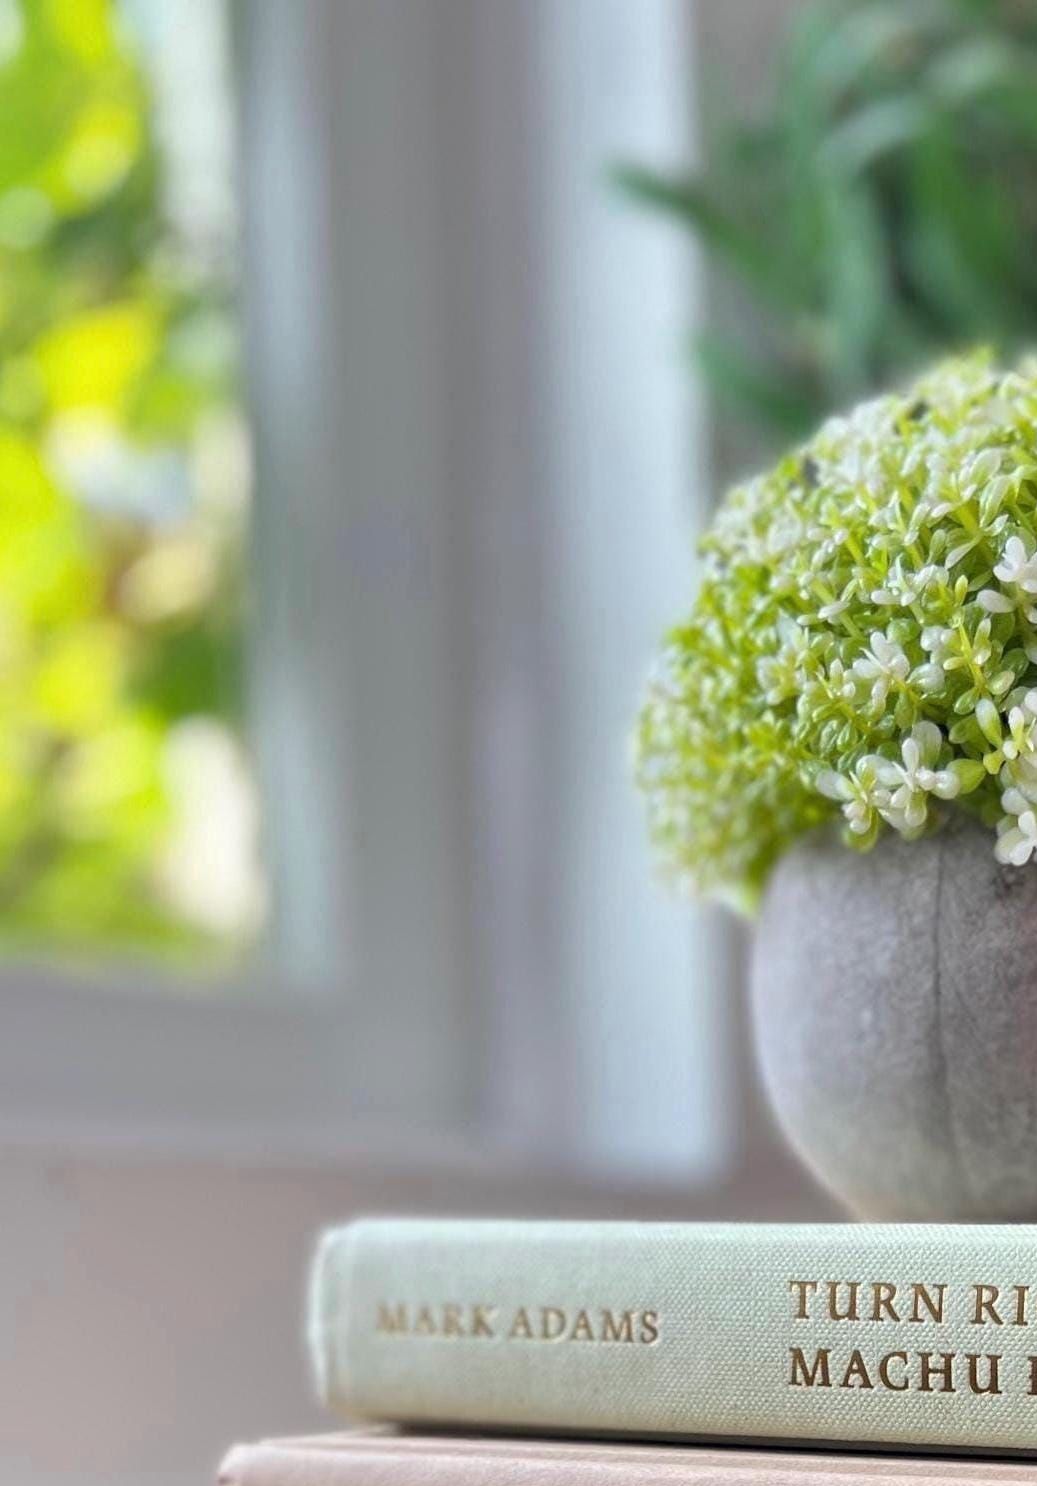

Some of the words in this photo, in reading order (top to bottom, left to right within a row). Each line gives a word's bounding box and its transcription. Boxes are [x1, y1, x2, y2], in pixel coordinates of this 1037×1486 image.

[373, 1299, 496, 1339] MARK
[511, 1304, 660, 1346] ADAMS
[787, 1280, 947, 1325] TURN
[788, 1345, 1002, 1396] MACHU
